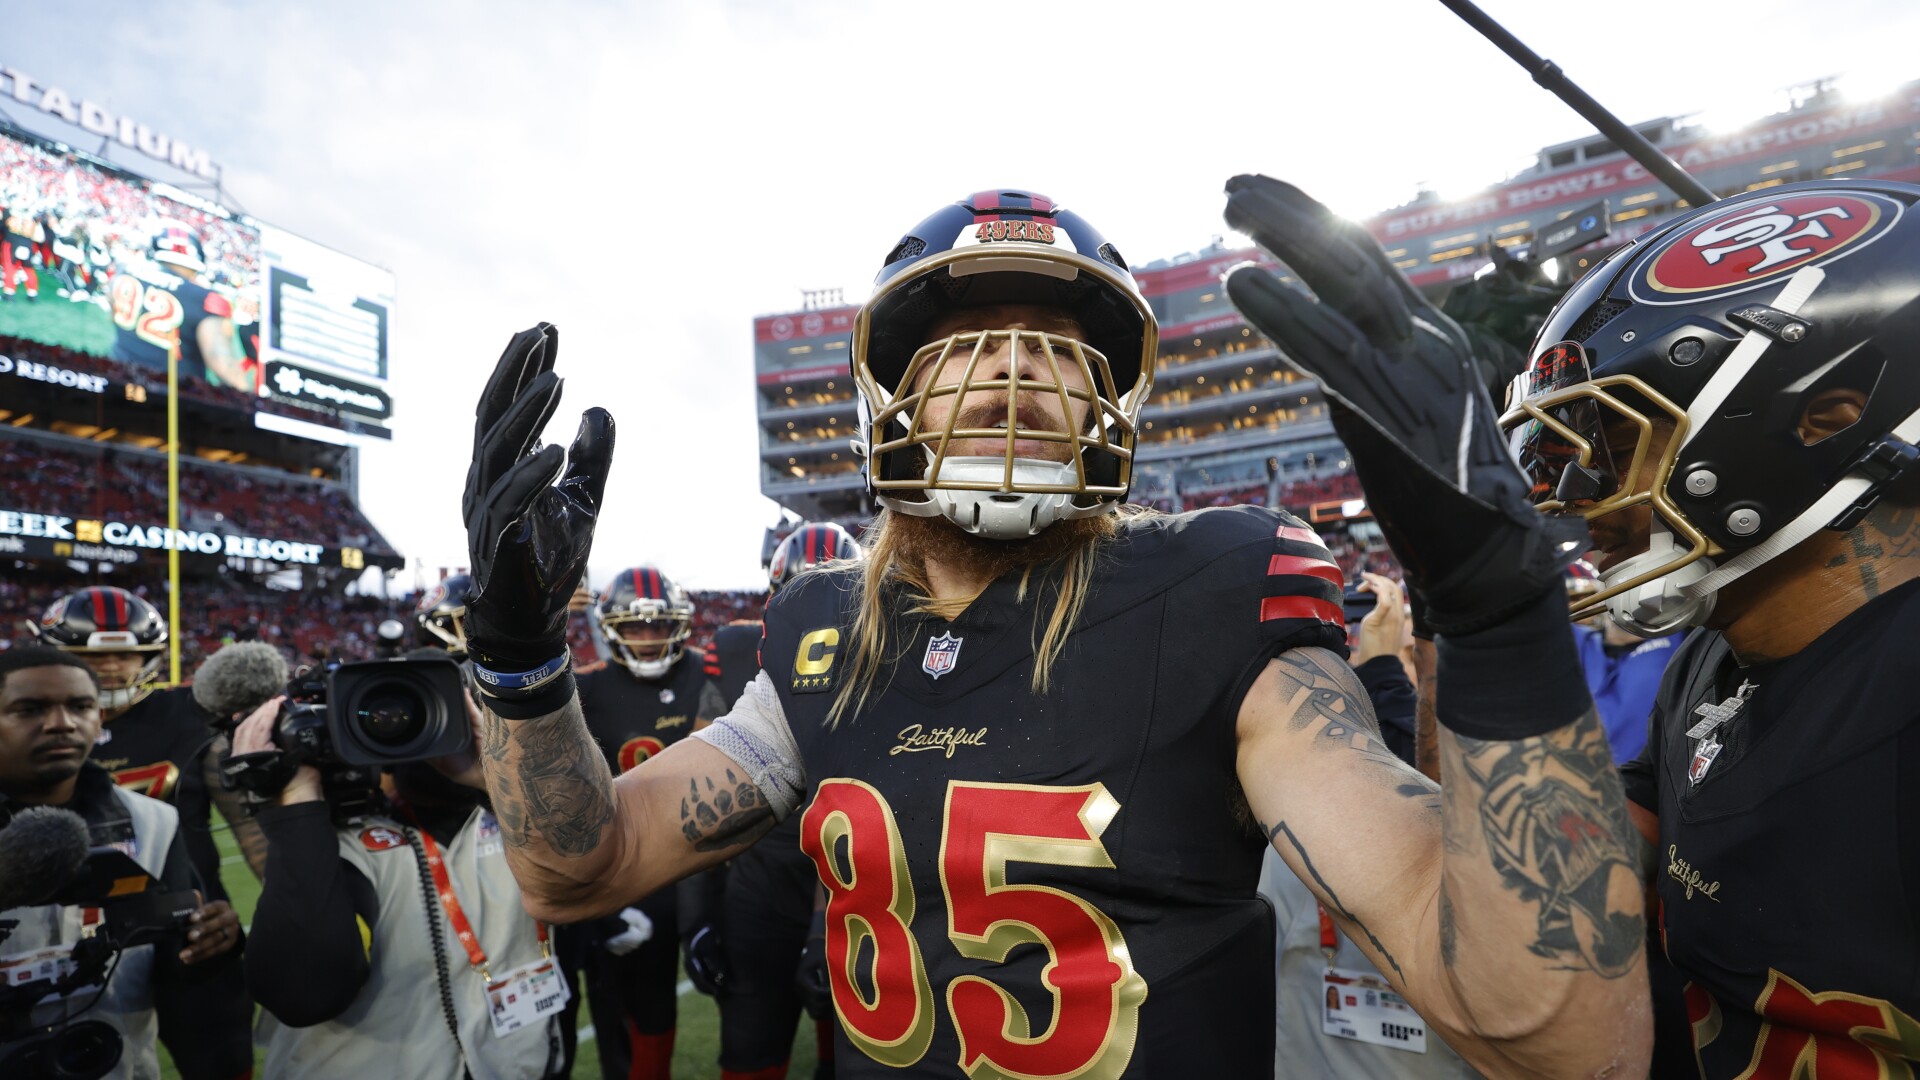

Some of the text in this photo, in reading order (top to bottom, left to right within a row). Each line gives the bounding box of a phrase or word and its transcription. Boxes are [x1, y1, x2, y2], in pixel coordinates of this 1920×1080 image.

[0, 65, 213, 178] TADIUM
[1386, 195, 1498, 237] SUPER
[1507, 169, 1617, 207] BOWL
[1622, 104, 1885, 180] CAMPIONS
[976, 220, 1055, 244] 49ERS
[112, 273, 184, 350] 92
[16, 359, 109, 393] RESORT
[103, 521, 222, 554] CASINO
[224, 534, 324, 564] RESORT
[523, 666, 549, 685] TEU
[795, 628, 840, 676] C
[889, 723, 987, 759] Faithful
[1667, 844, 1721, 904] Faithful
[800, 776, 1148, 1080] 85
